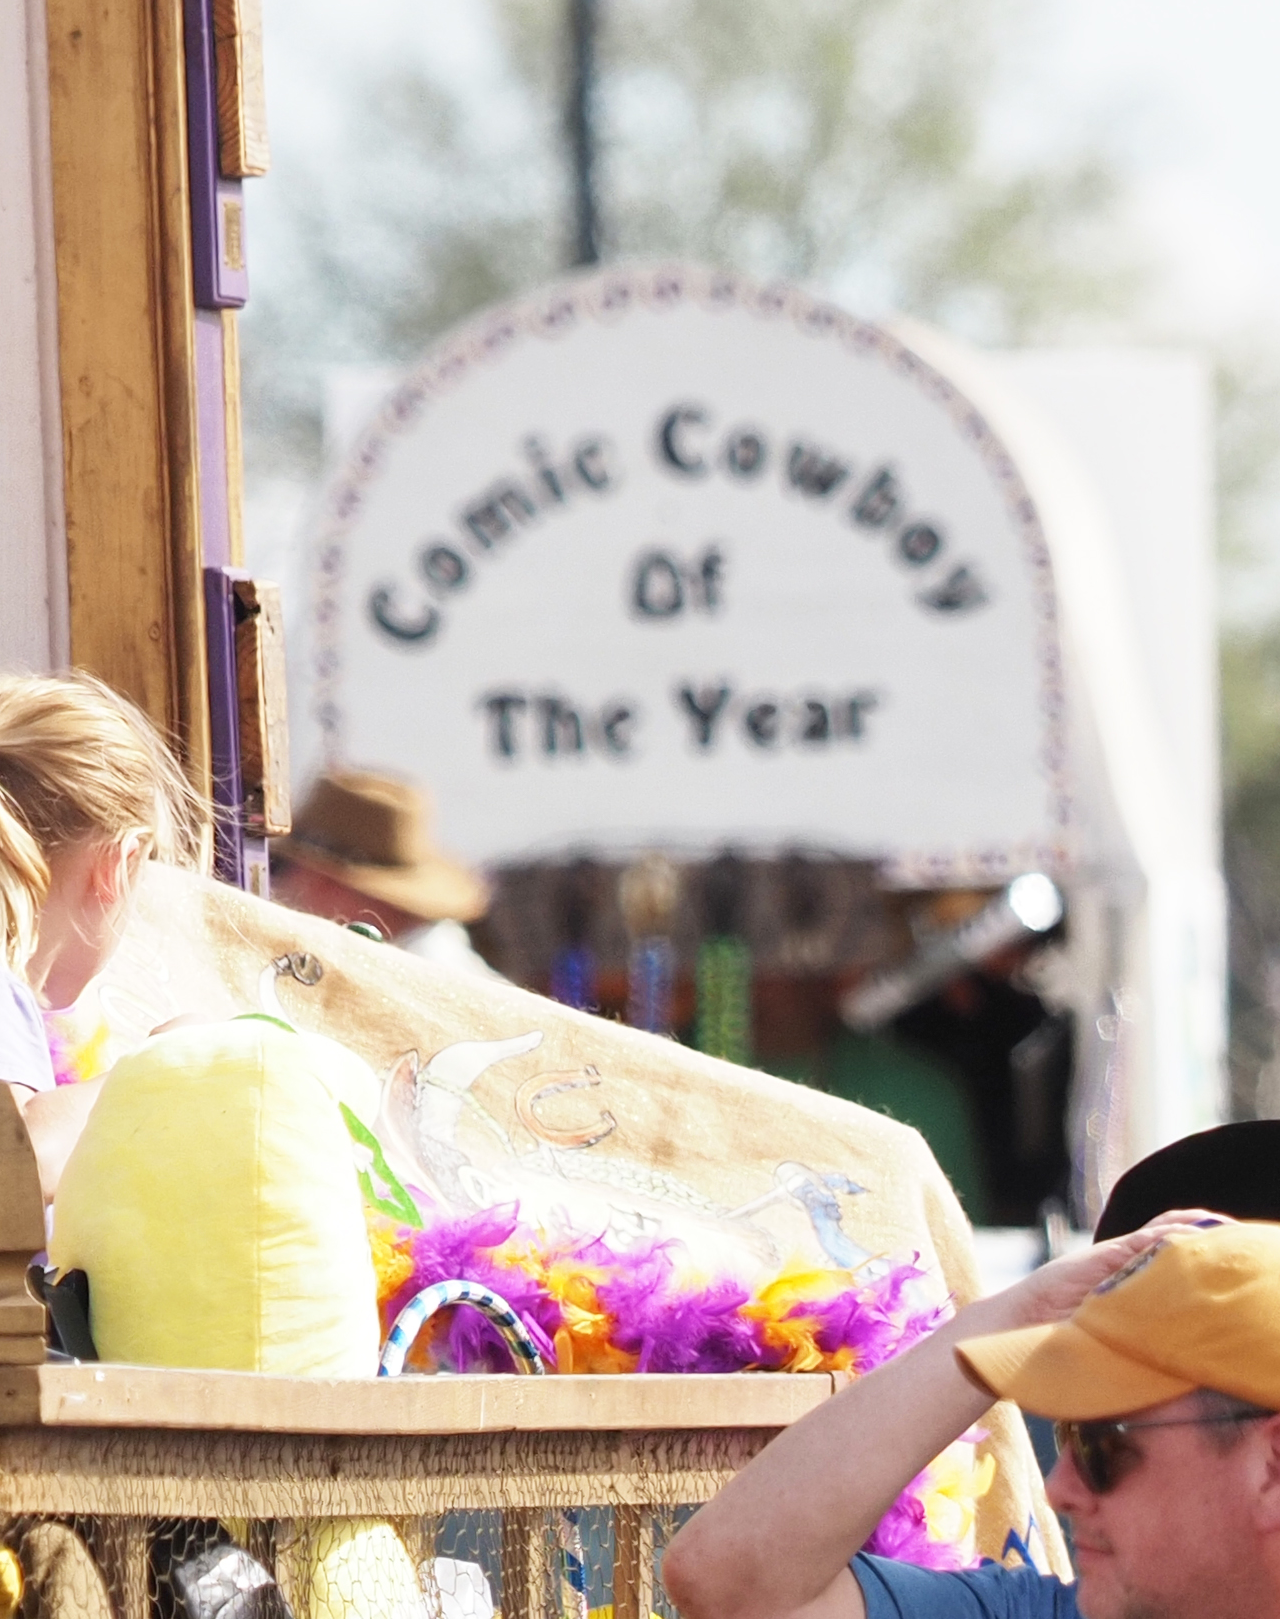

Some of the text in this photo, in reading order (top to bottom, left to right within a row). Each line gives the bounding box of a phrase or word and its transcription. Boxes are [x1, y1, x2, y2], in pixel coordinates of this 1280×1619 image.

[371, 403, 985, 645] Comic Cowboy
[634, 548, 726, 618] Of
[482, 683, 878, 758] The Year
